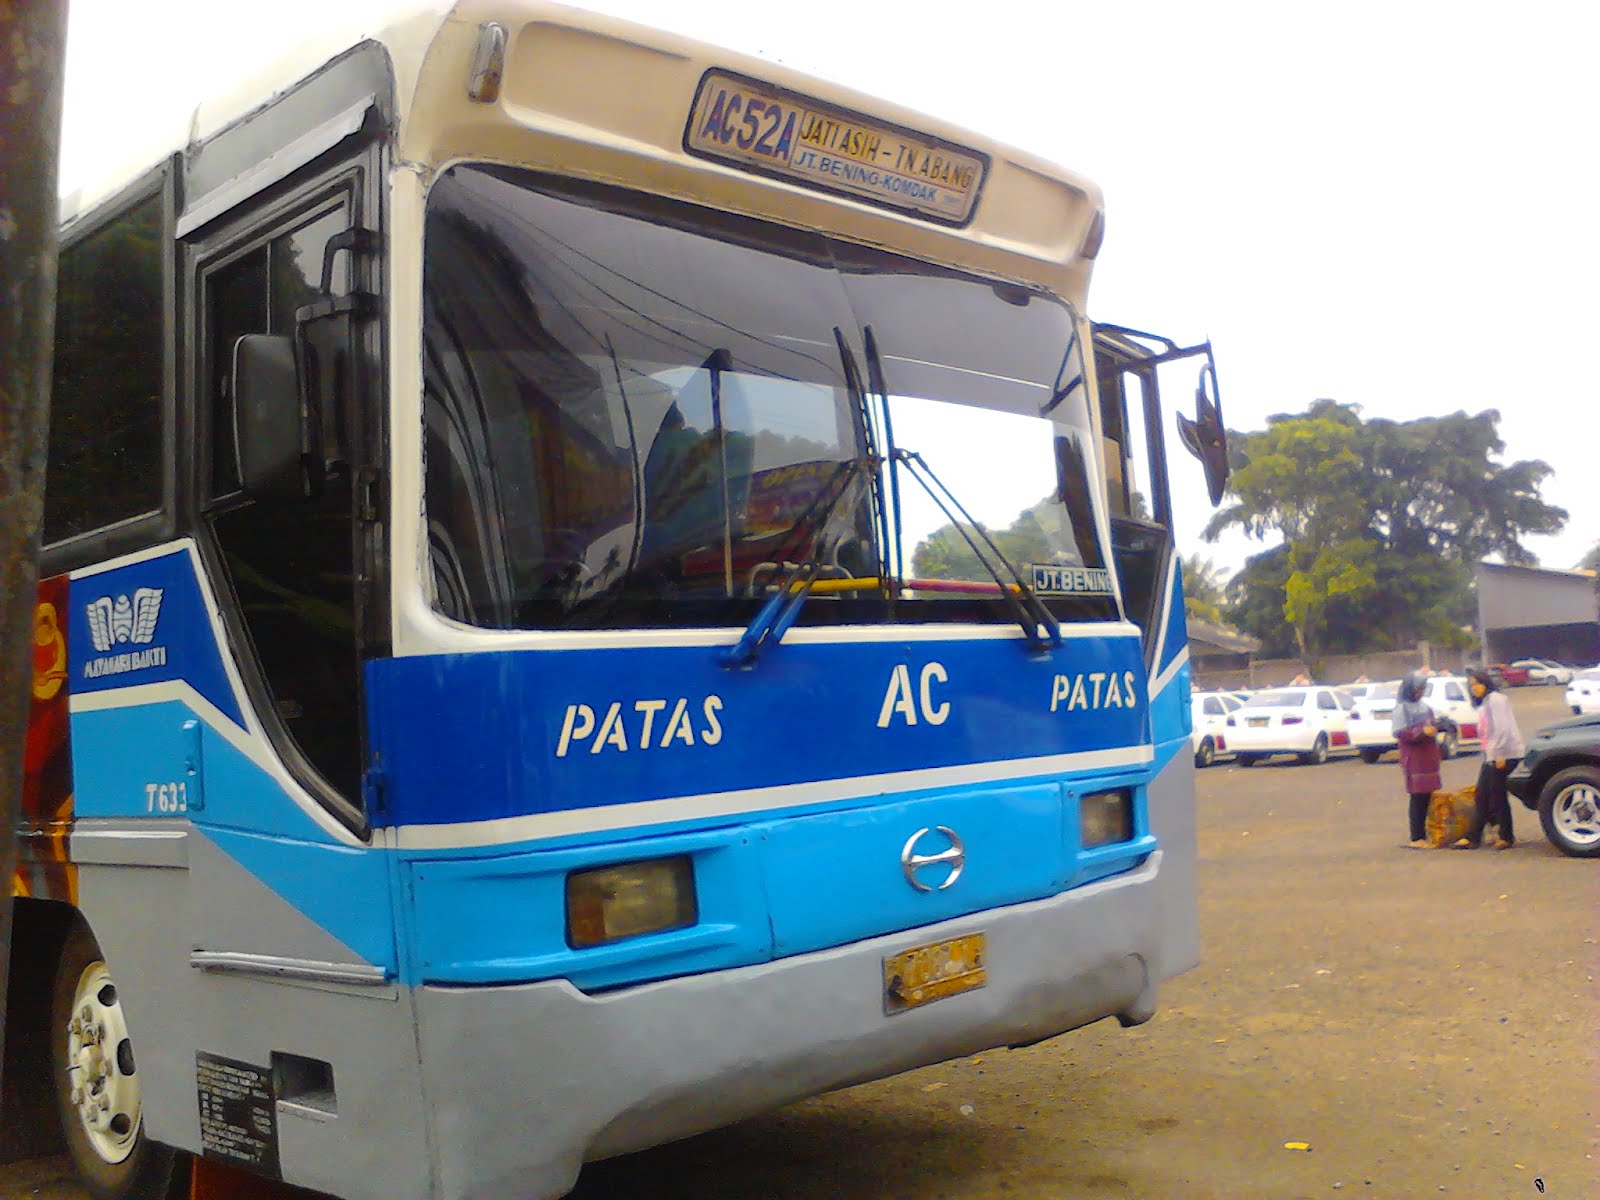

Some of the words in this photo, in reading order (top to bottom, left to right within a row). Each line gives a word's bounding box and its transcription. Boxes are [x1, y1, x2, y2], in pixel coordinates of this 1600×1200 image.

[702, 89, 797, 160] AC52A
[801, 116, 839, 148] JATI
[840, 128, 880, 161] ASIH
[876, 661, 950, 728] AC
[1050, 671, 1136, 712] PATAS
[556, 695, 723, 757] PATAS
